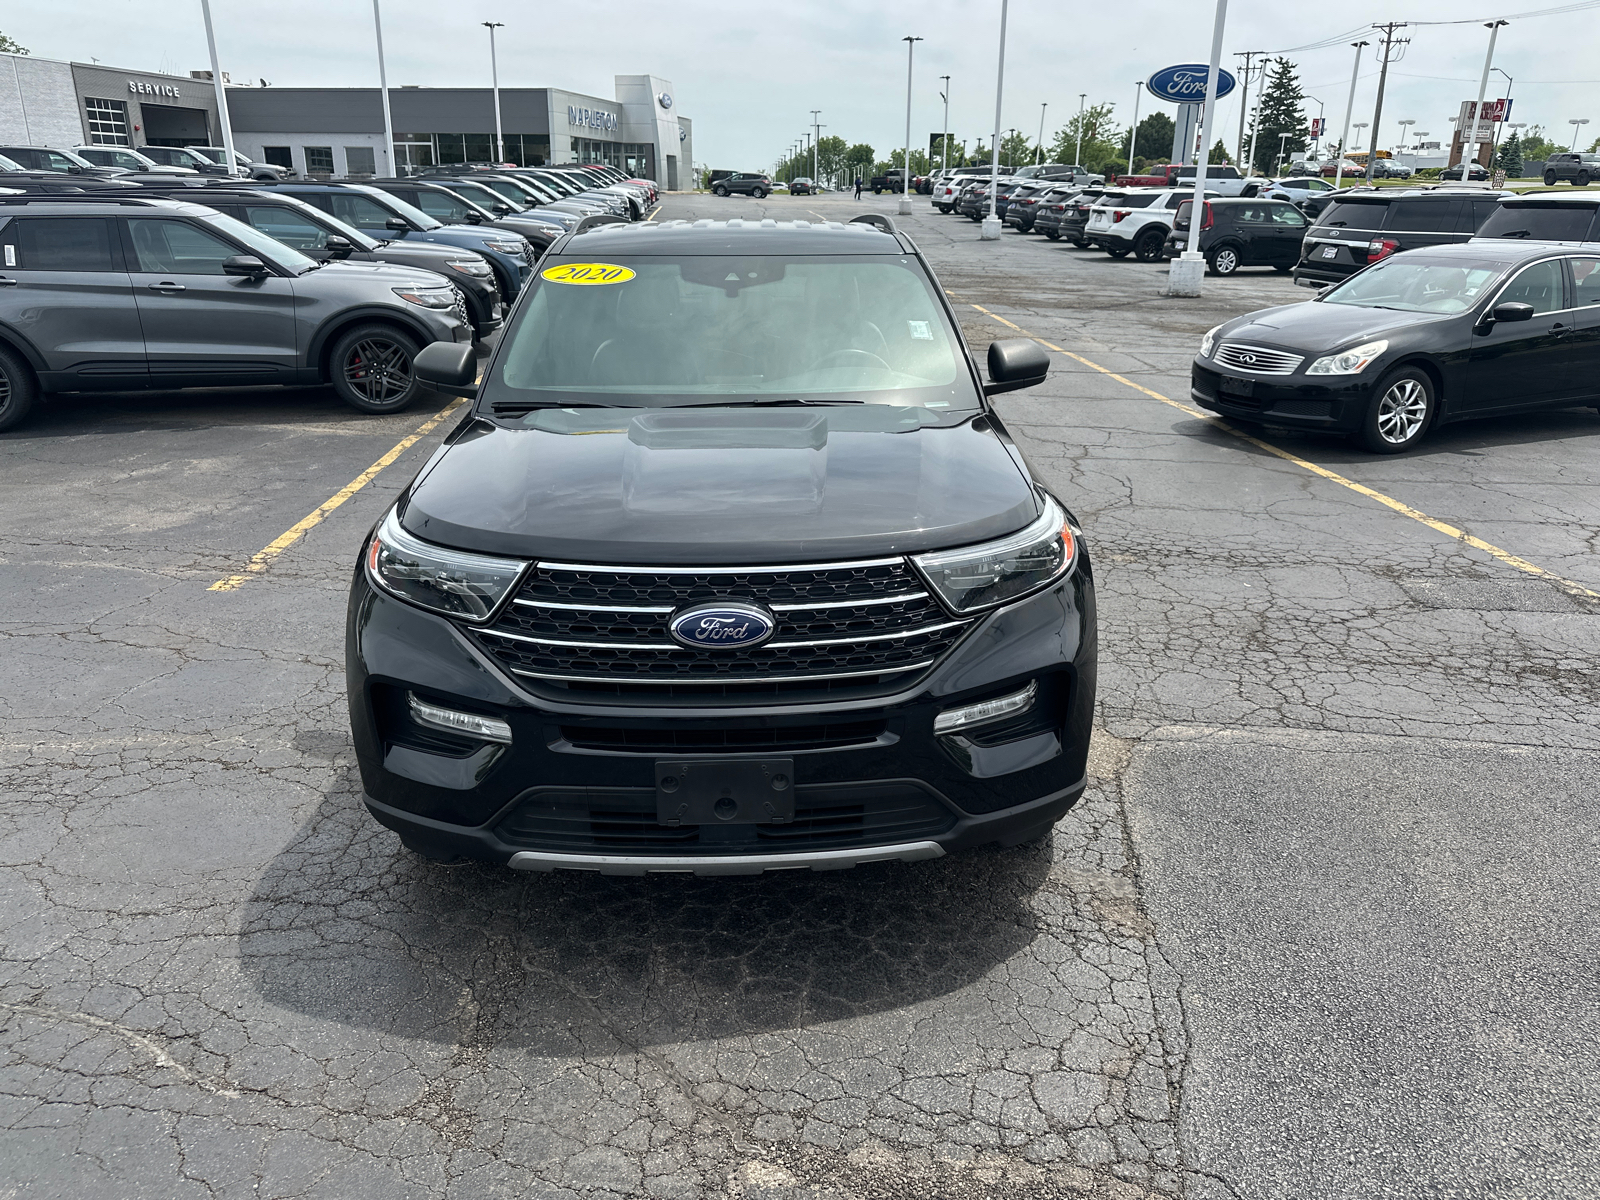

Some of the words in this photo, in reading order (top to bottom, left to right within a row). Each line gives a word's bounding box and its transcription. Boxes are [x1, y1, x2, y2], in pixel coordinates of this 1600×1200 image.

[129, 80, 180, 98] SERVICE
[568, 105, 618, 131] NAPLETON
[554, 267, 623, 281] 2020
[695, 617, 749, 639] Ford
